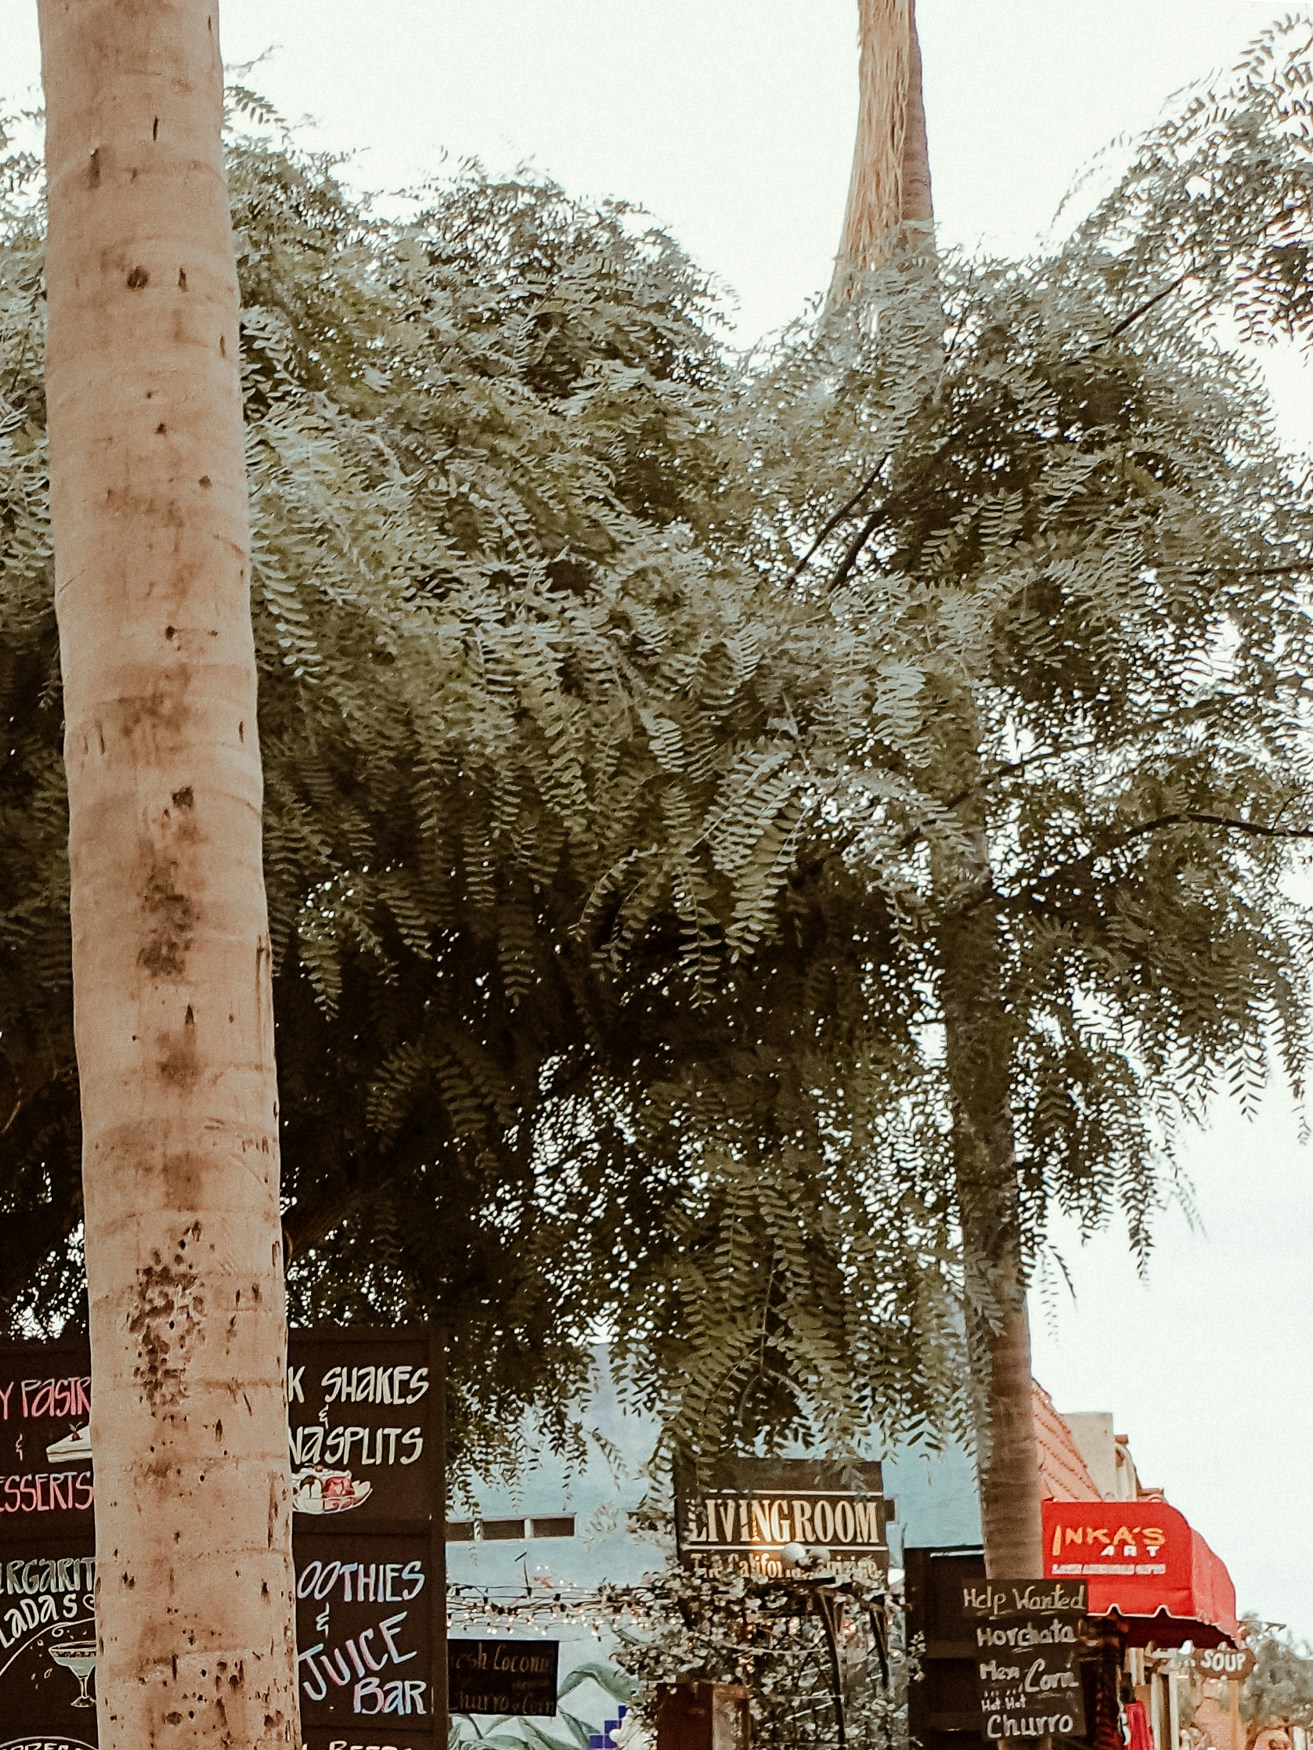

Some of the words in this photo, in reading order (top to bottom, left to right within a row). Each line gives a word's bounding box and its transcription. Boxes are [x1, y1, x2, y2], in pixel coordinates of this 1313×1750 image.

[21, 1374, 92, 1417] PASTR
[1052, 1525, 1166, 1556] INKA'S
[1100, 1545, 1163, 1557] ART
[298, 1560, 426, 1604] OOTHIES
[963, 1586, 1006, 1618] Help
[1012, 1584, 1086, 1611] Wanted
[977, 1619, 1079, 1648] Horchata
[296, 1611, 418, 1702] JUICE
[1200, 1650, 1246, 1672] SOUP
[1025, 1657, 1080, 1693] Corn
[987, 1713, 1074, 1738] Churro
